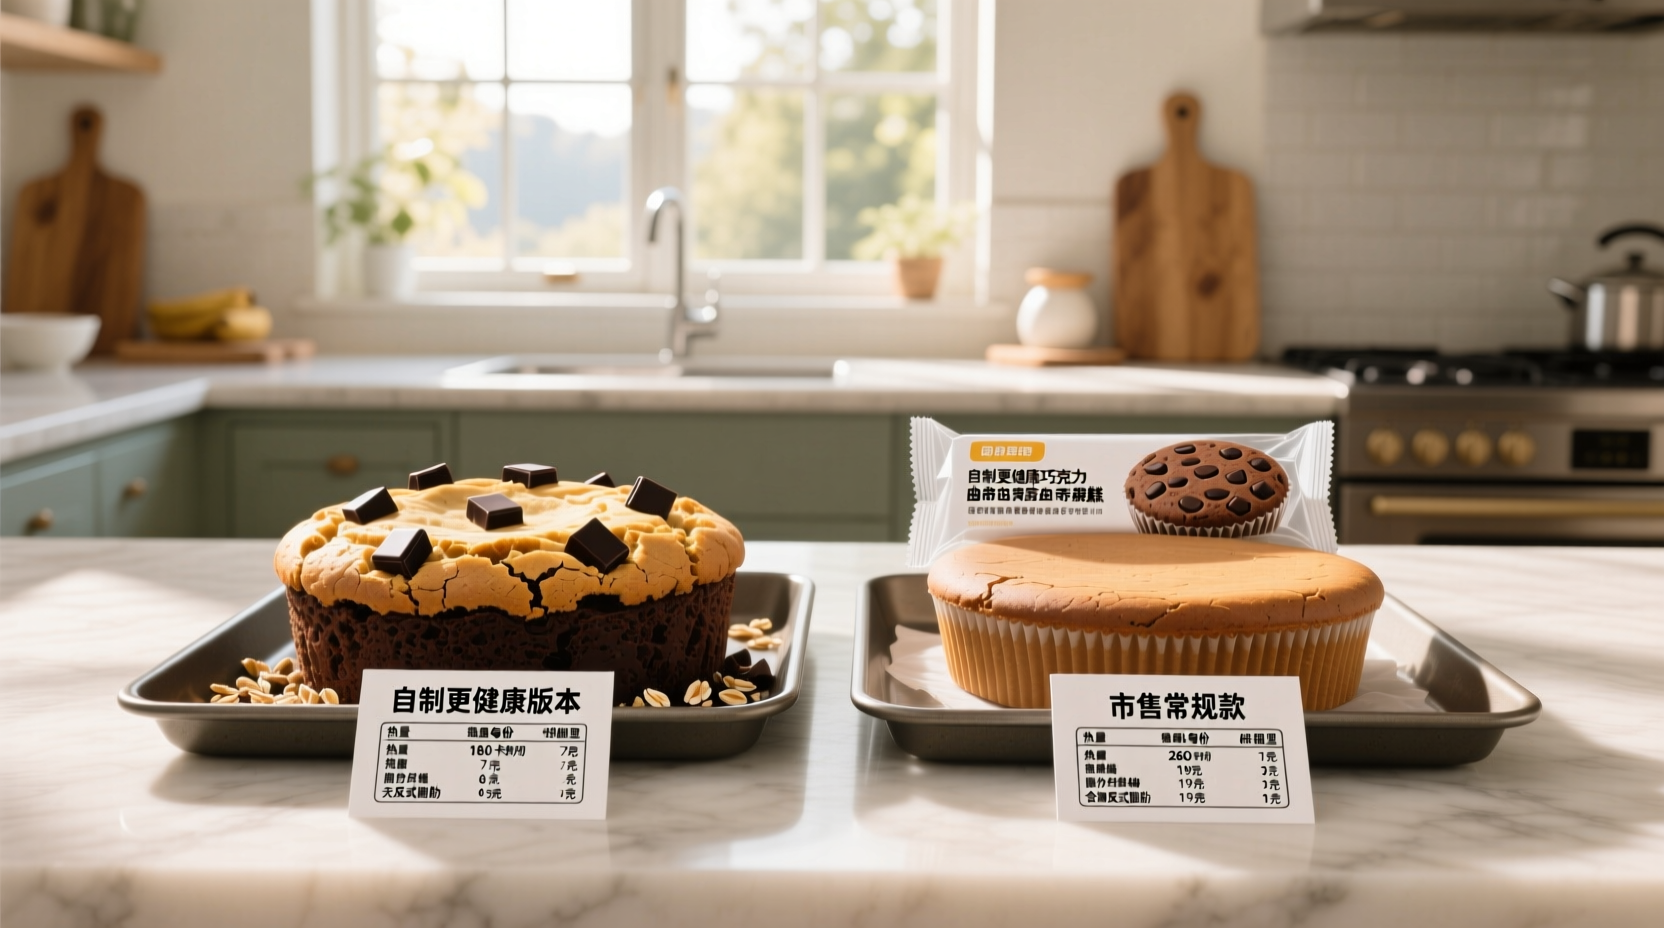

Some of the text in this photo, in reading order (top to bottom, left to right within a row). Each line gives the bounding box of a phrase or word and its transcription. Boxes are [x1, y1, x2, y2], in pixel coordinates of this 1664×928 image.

[393, 686, 581, 714] 自制更健康版本
[1109, 692, 1246, 721] 市售常规款
[1168, 750, 1192, 761] 260
